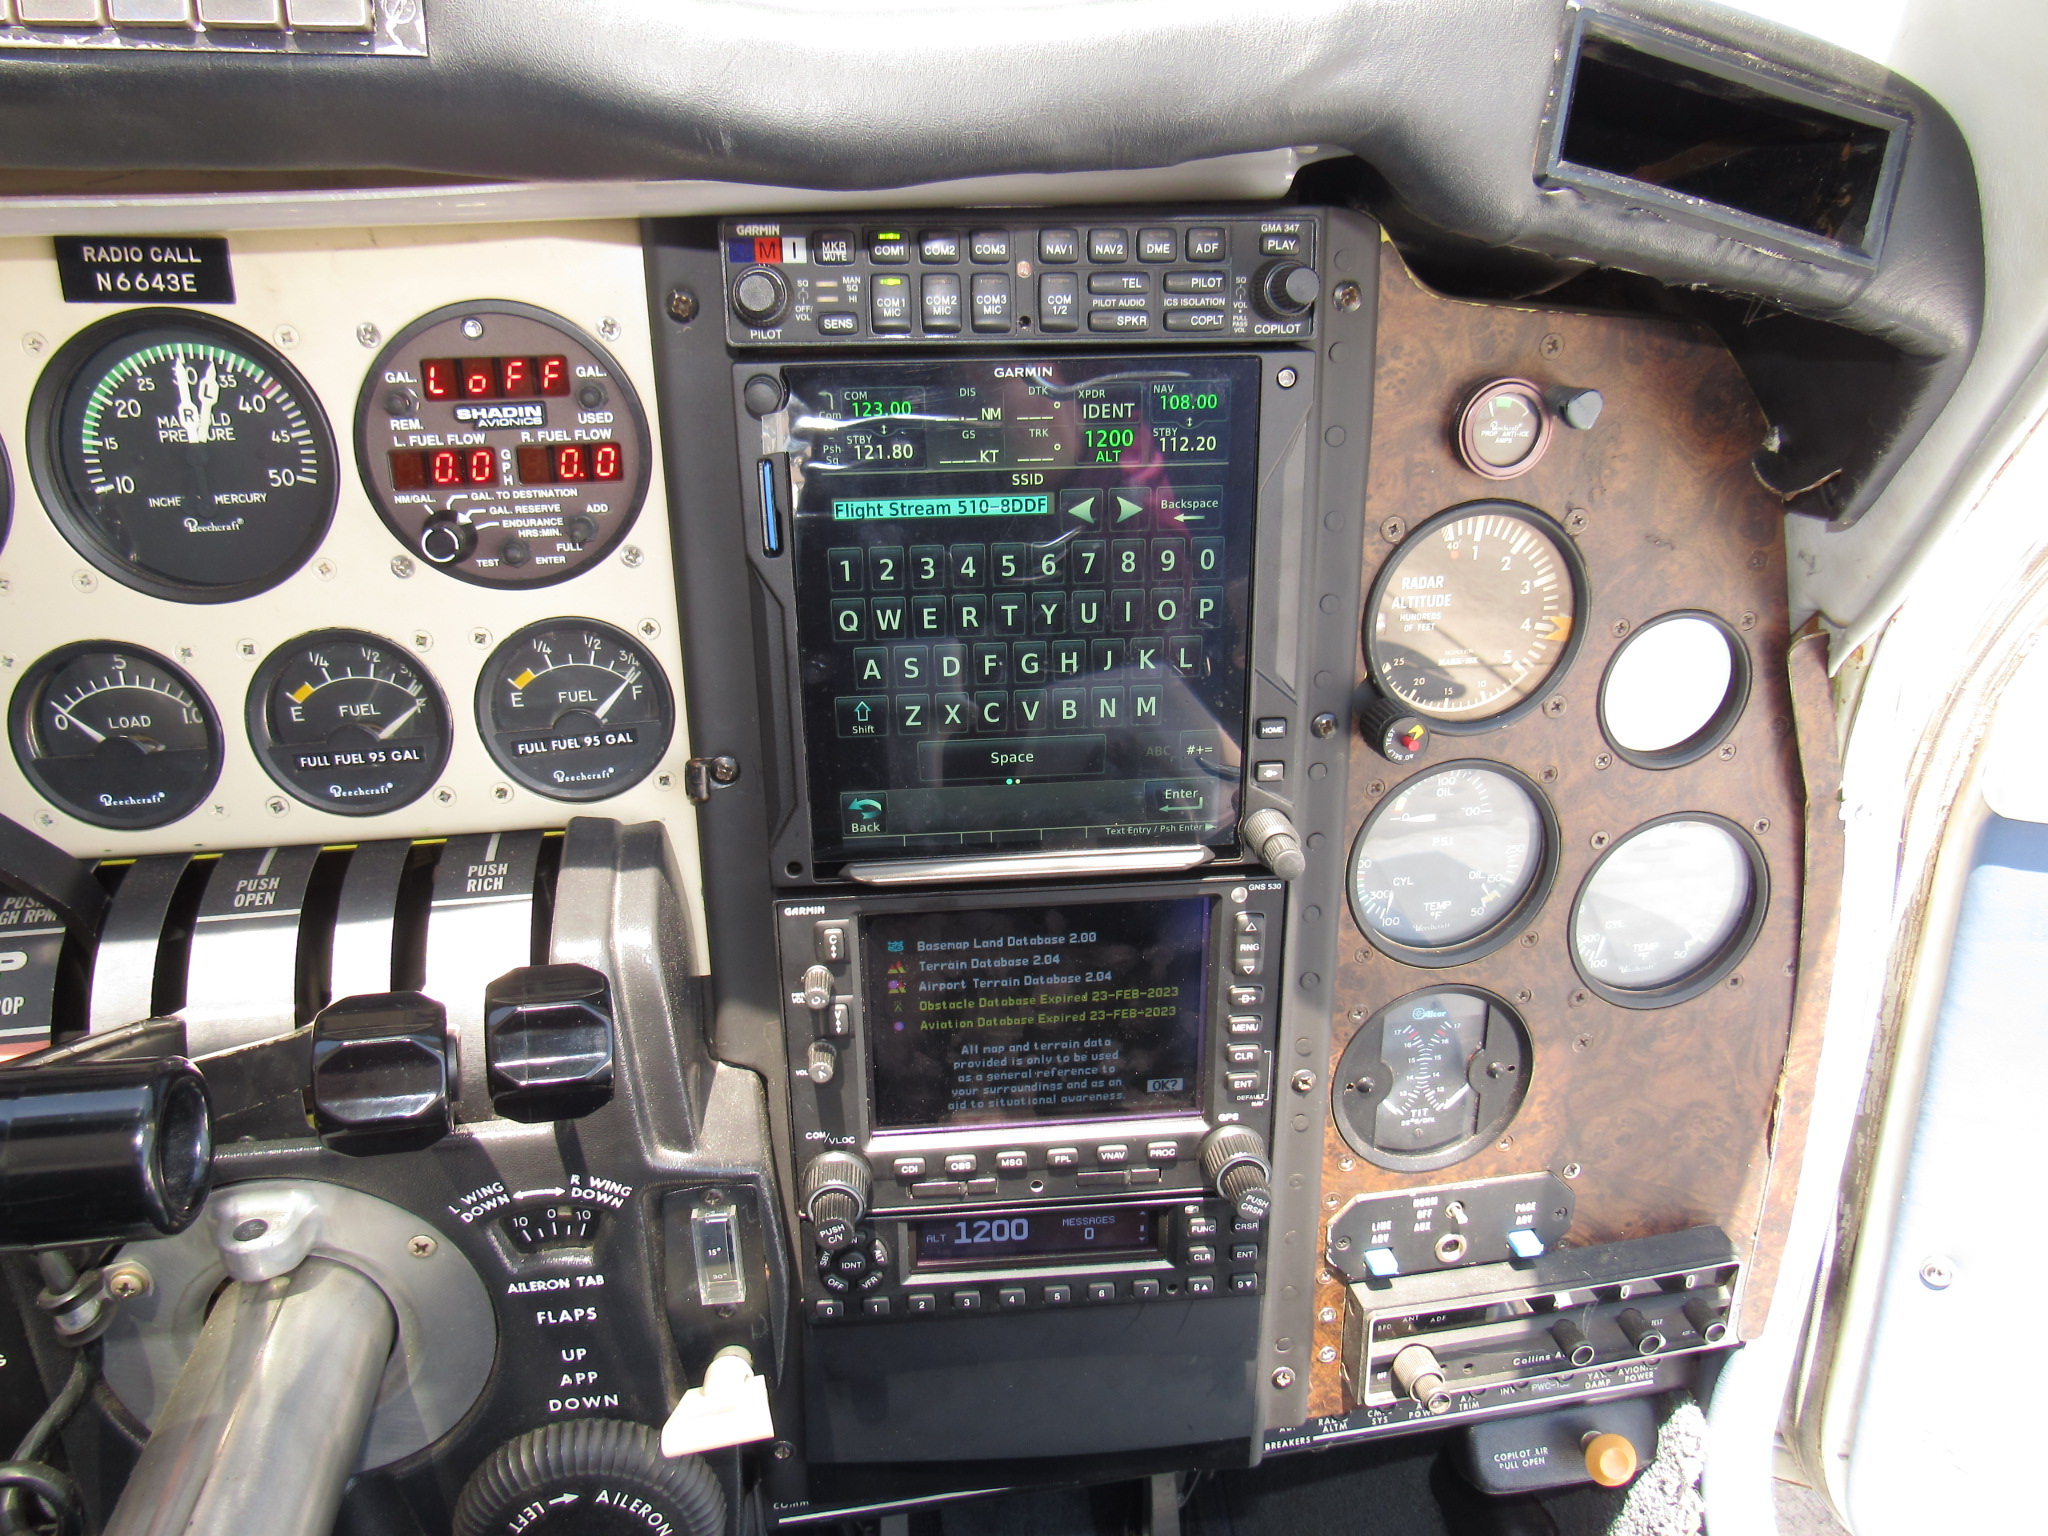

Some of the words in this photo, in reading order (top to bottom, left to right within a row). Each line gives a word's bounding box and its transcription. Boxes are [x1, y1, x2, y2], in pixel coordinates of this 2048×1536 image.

[736, 225, 780, 236] GARMIN
[1261, 224, 1282, 232] GMA
[1284, 224, 1299, 232] 347
[822, 242, 846, 251] MKR
[874, 246, 904, 256] COM1
[924, 246, 955, 255] COM2
[975, 245, 1006, 255] COM3
[1046, 245, 1073, 255] NAV1
[1096, 245, 1123, 255] NAV2
[1147, 244, 1170, 253] DME
[1196, 243, 1219, 253] ADF
[1268, 240, 1296, 251] PLAY
[82, 246, 143, 263] RADIO
[150, 247, 202, 263] CALL
[823, 253, 847, 261] MUTE
[96, 273, 198, 293] N6643E
[1122, 278, 1142, 288] TEL
[1191, 278, 1222, 288] PILOT
[1093, 299, 1117, 307] PILOT
[1118, 298, 1145, 307] AUDIO
[1164, 298, 1179, 306] ICS
[1180, 298, 1225, 306] ISOLATION
[824, 319, 853, 329] SENS
[1117, 316, 1147, 326] SPKR
[1191, 315, 1224, 325] COPLT
[750, 330, 782, 339] PILOT
[1254, 324, 1301, 334] COPILOT
[384, 371, 417, 383] GAL.
[575, 366, 607, 377] GAL.
[994, 367, 1053, 379] GARMIN
[960, 388, 976, 397] DIS
[1079, 390, 1105, 398] XPDR
[1154, 385, 1174, 393] NAV
[1161, 395, 1218, 410] 108.00
[115, 400, 142, 418] 20
[456, 405, 542, 420] SHADIN
[852, 401, 912, 417] 123.00
[981, 408, 1001, 420] NM
[1083, 403, 1135, 419] IDENT
[578, 412, 614, 424] USED
[390, 419, 424, 430] REM.
[409, 435, 444, 446] FUEL
[447, 433, 486, 445] FLOW
[537, 430, 571, 442] FUEL
[575, 428, 612, 441] FLOW
[1085, 429, 1134, 448] 1200
[1160, 436, 1217, 452] 112.20
[854, 444, 914, 460] 121.80
[980, 450, 999, 463] KT
[1096, 450, 1121, 462] ALT
[268, 468, 295, 488] 50
[214, 492, 267, 505] MERCURY
[395, 495, 436, 504] NM/GAL.
[470, 491, 494, 501] GAL.
[496, 491, 510, 500] TO
[513, 487, 578, 499] DESTINATION
[586, 504, 608, 513] ADD
[1161, 500, 1218, 510] Backspace
[834, 503, 884, 520] Flight
[889, 502, 950, 517] Stream
[502, 517, 564, 527] ENDURANCE
[556, 543, 583, 552] FULL
[477, 559, 499, 567] TEST
[1401, 575, 1444, 590] RADAR
[1391, 594, 1452, 610] ALTITUDE
[1400, 612, 1441, 622] HUNDREDS
[558, 690, 598, 703] FUEL
[339, 704, 381, 717] FUEL
[108, 715, 151, 729] LOAD
[852, 725, 874, 734] Shift
[1262, 726, 1283, 734] HOME
[518, 742, 547, 755] FULL
[552, 738, 580, 750] FUEL
[584, 736, 601, 747] 95
[605, 732, 633, 744] GAL
[300, 756, 330, 768] FULL
[335, 754, 365, 765] FUEL
[369, 751, 386, 763] 95
[392, 750, 420, 761] GAL
[990, 752, 1034, 766] Space
[852, 822, 880, 833] Back
[1106, 827, 1125, 835] Text
[1127, 826, 1151, 836] Entry
[467, 863, 508, 878] PUSH
[235, 877, 280, 893] PUSH
[466, 878, 504, 893] RICH
[1393, 877, 1413, 886] CYL
[234, 891, 276, 907] OPEN
[784, 906, 825, 916] GARMIN
[917, 941, 969, 951] Basemap
[974, 938, 1003, 948] Land
[1008, 936, 1063, 946] Database
[1069, 932, 1096, 943] 2.00
[1240, 943, 1259, 951] RNG
[919, 960, 967, 971] Terrain
[971, 958, 1028, 969] Database
[1032, 955, 1059, 966] 2.04
[919, 980, 966, 992] Airport
[973, 978, 1019, 988] Terrain
[1023, 974, 1080, 985] Database
[1084, 971, 1111, 982] 2.04
[919, 1000, 975, 1011] Obstacle
[979, 997, 1035, 1008] Database
[1039, 992, 1088, 1004] Expired
[920, 1019, 974, 1030] Aviation
[977, 1016, 1032, 1027] Database
[1038, 1013, 1085, 1024] Expired
[1152, 1080, 1178, 1091] OK?
[1234, 1080, 1252, 1088] ENT
[1150, 1148, 1175, 1157] PROC
[1001, 1158, 1023, 1166] MSG
[1055, 1155, 1071, 1163] FPL
[901, 1165, 918, 1174] CDI
[951, 1162, 971, 1170] OBS
[590, 1175, 633, 1197] WING
[460, 1181, 505, 1206] WING
[1515, 1202, 1536, 1213] PAGE
[1063, 1216, 1115, 1226] MESSAGES
[1235, 1222, 1258, 1230] CRSR
[1372, 1220, 1392, 1231] LINE
[819, 1224, 845, 1238] PUSH
[955, 1219, 1029, 1244] 1200
[1191, 1224, 1214, 1232] FUNC
[841, 1261, 862, 1269] IDNT
[507, 1277, 570, 1294] AILERON
[576, 1274, 605, 1288] TAB
[536, 1306, 598, 1325] FLAPS
[561, 1348, 587, 1362] UP
[1513, 1354, 1550, 1366] Collins
[560, 1371, 599, 1387] APP
[1625, 1371, 1654, 1382] POWER
[1585, 1379, 1611, 1390] DAMP
[549, 1394, 619, 1412] DOWN
[1459, 1401, 1480, 1410] TRIM
[1371, 1415, 1388, 1425] SYS
[1322, 1423, 1348, 1433] ALTM
[1265, 1436, 1311, 1451] BREAKERS
[1494, 1448, 1531, 1462] COPILOT
[1535, 1447, 1548, 1457] AIR
[595, 1488, 674, 1536] AILERON
